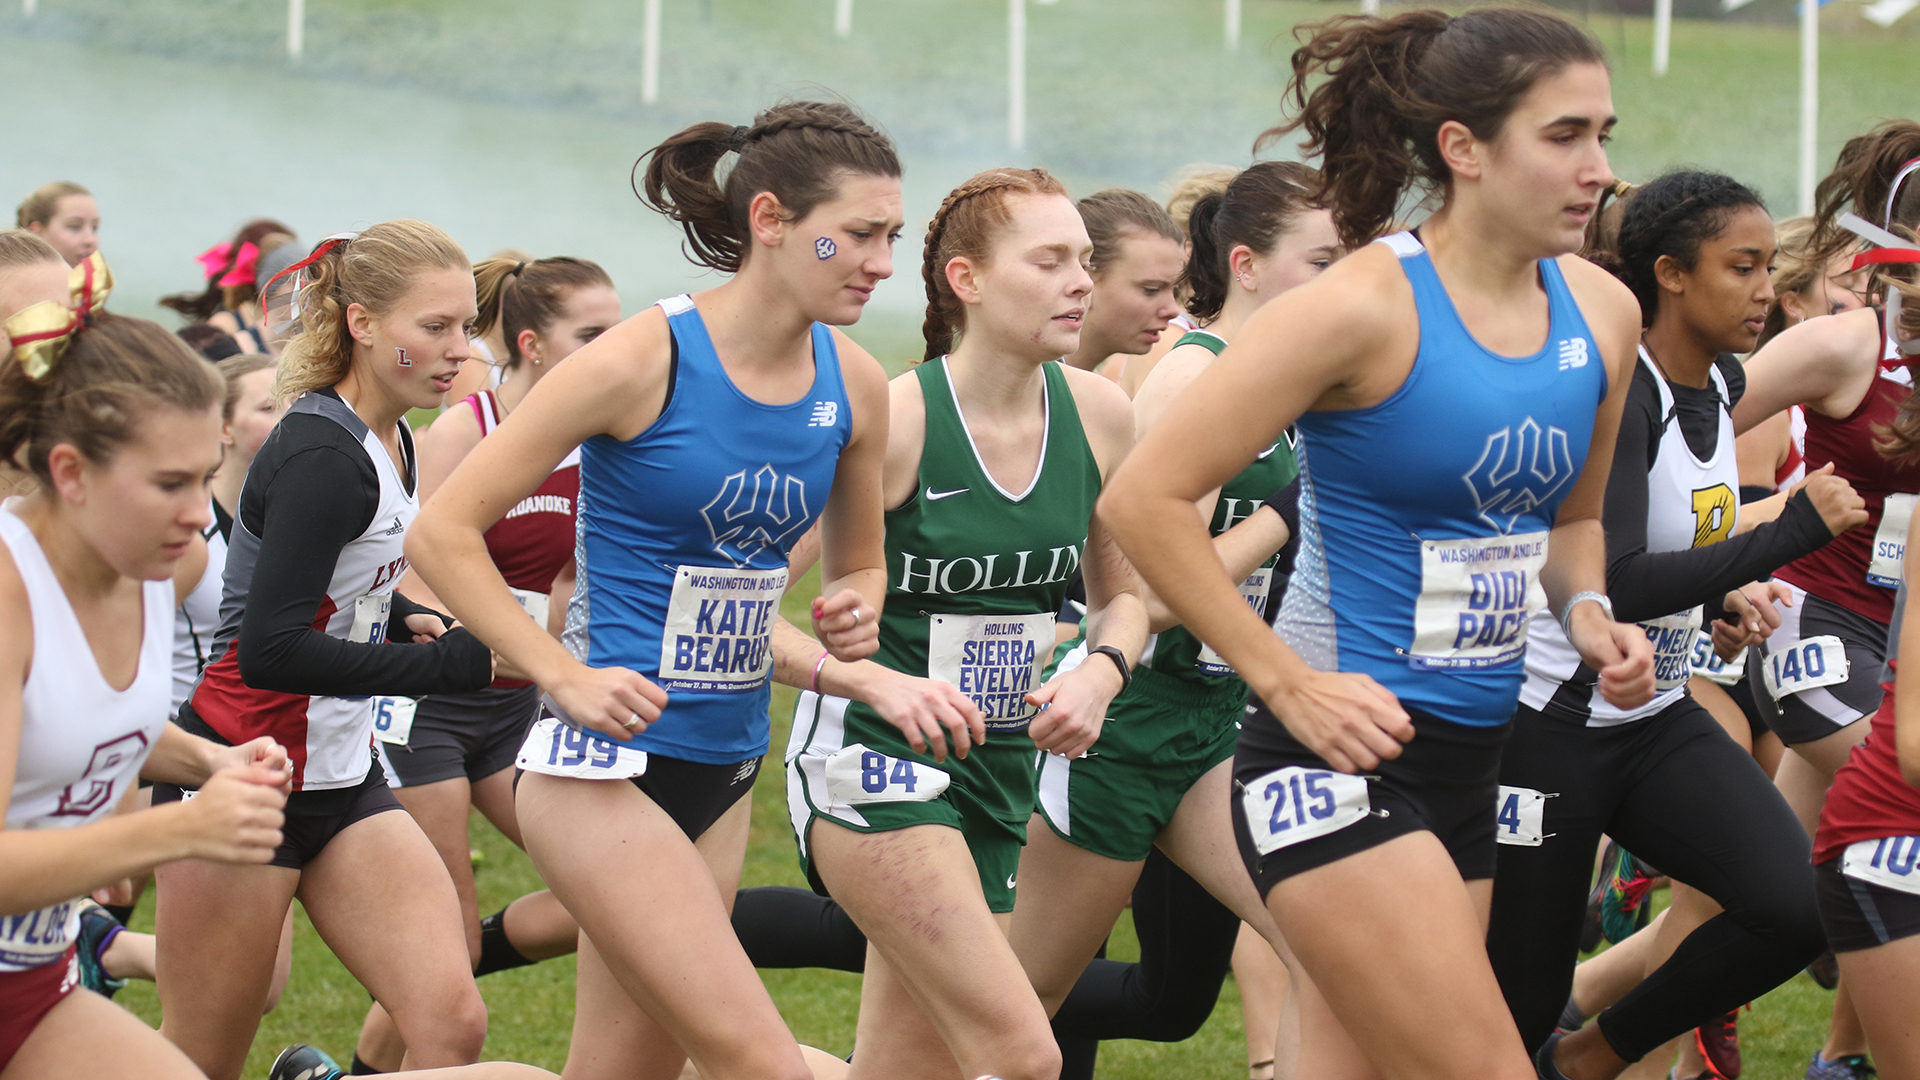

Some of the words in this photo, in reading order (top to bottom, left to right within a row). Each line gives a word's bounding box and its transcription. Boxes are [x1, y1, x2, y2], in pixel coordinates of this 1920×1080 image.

[395, 346, 412, 368] L
[1439, 545, 1511, 563] WASHINGTON
[1514, 543, 1532, 559] AND
[690, 575, 757, 590] WASHINGTON
[758, 577, 775, 591] AND
[775, 575, 786, 590] LEE
[1468, 570, 1526, 611] DIDI
[695, 599, 774, 635] KATIE
[984, 623, 1024, 635] HOLLINS
[674, 634, 769, 673] BEARUP
[962, 640, 1035, 665] SIERRA
[1773, 642, 1826, 690] 140
[960, 665, 1033, 692] EVELYN
[372, 696, 395, 732] 6
[967, 692, 1029, 718] OSTER
[548, 723, 619, 769] 199
[861, 751, 918, 793] 84
[1264, 772, 1337, 835] 215
[1870, 835, 1920, 877] 10
[0, 904, 70, 944] YLOR
